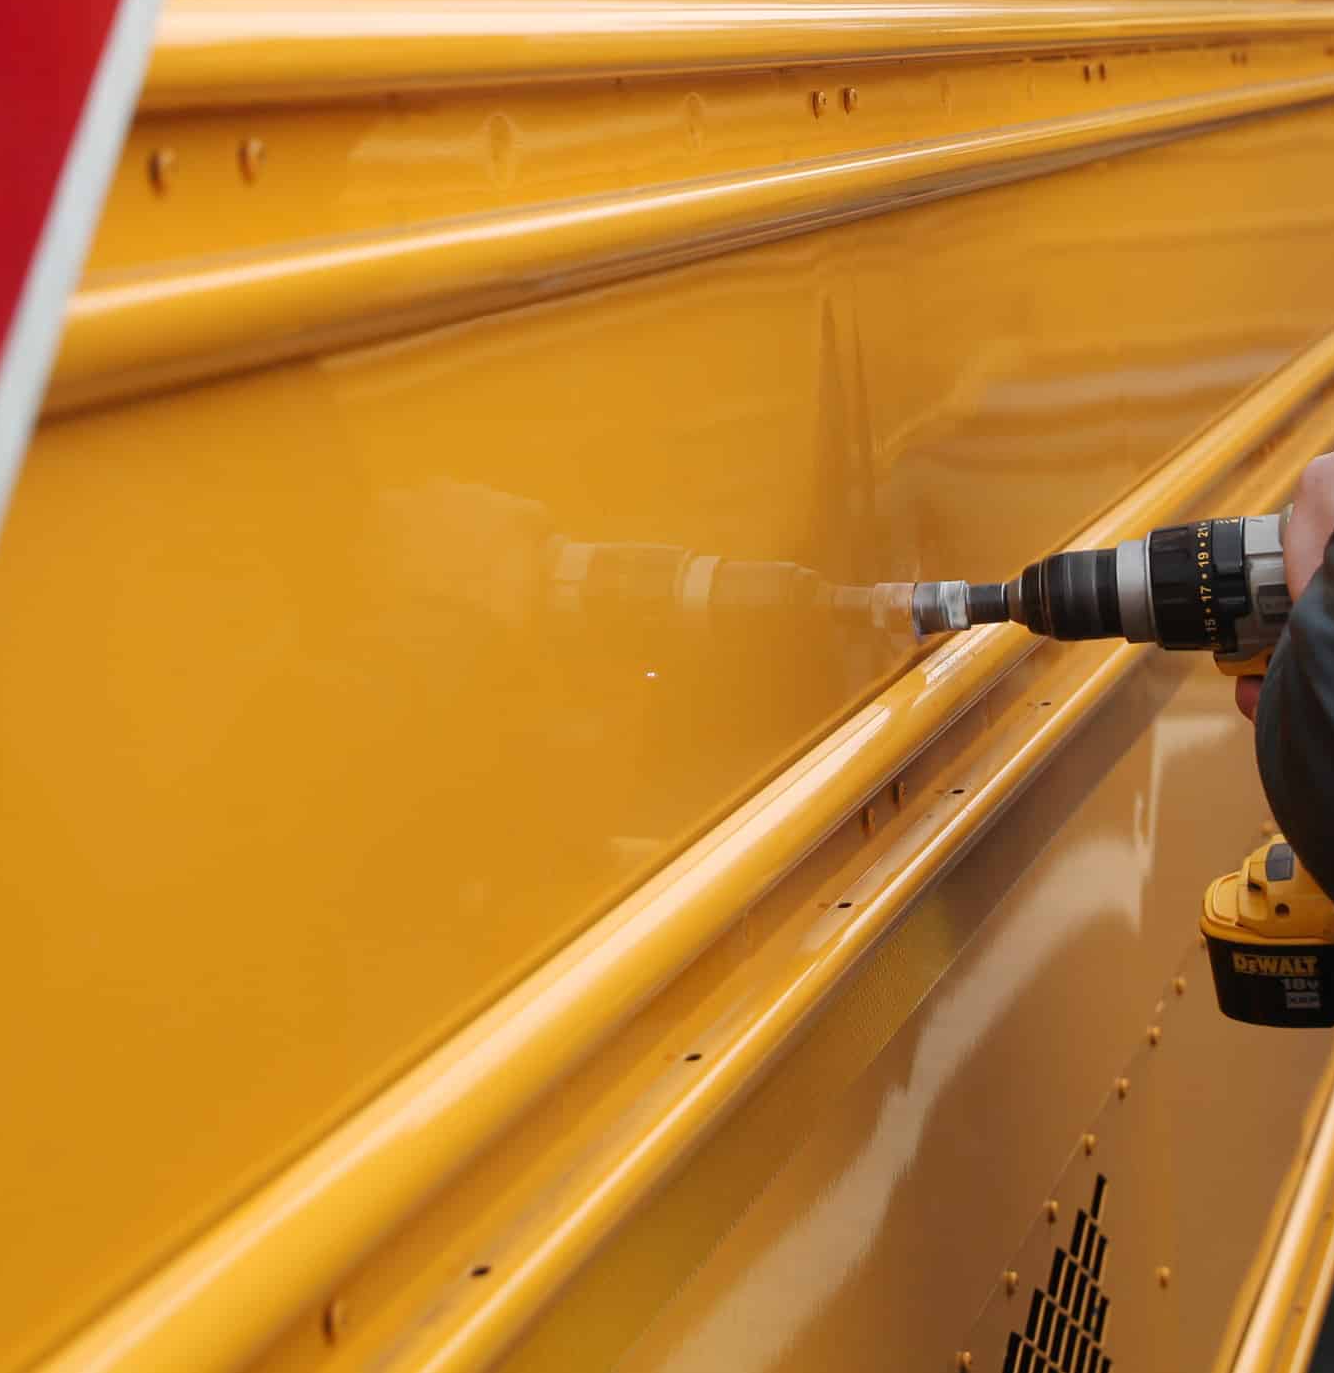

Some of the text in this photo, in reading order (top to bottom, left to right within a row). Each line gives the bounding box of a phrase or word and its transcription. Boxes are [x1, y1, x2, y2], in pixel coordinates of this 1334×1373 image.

[1197, 552, 1210, 567] 19
[1200, 586, 1211, 602] 17
[1234, 952, 1317, 975] DEWALT
